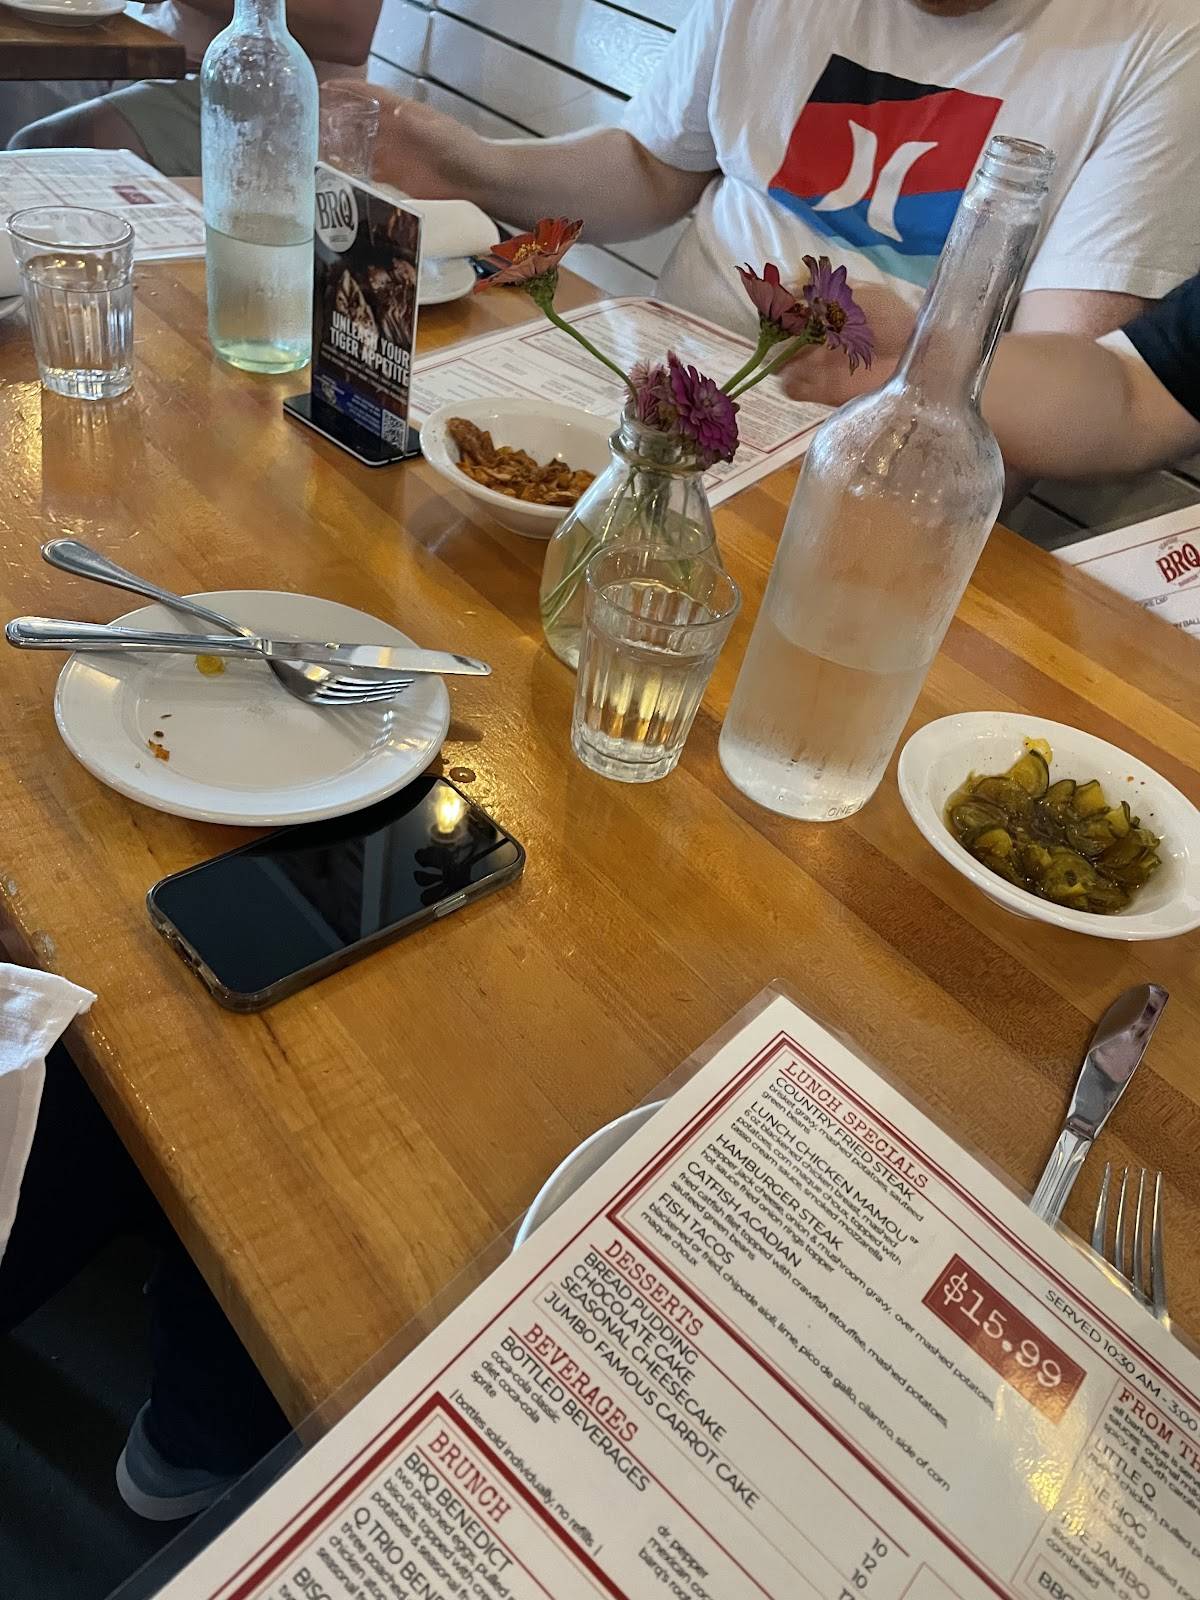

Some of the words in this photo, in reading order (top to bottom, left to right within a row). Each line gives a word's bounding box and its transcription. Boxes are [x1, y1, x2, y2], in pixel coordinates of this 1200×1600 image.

[316, 188, 354, 232] BRQ
[330, 327, 359, 358] TIGER
[361, 346, 410, 387] APPETITE
[332, 310, 378, 351] UNLEASH
[380, 338, 411, 369] YOUR
[1156, 543, 1200, 583] BRQ
[750, 1100, 797, 1143] LUNCH
[795, 1141, 854, 1194] CHICKEN
[760, 1090, 787, 1114] green
[784, 1109, 811, 1135] beans
[768, 1083, 796, 1109] brisket
[793, 1106, 819, 1132] gravy,
[818, 1127, 853, 1159] mashed
[776, 1077, 837, 1128] COUNTRY
[834, 1127, 873, 1163] FRIED
[872, 1161, 915, 1201] STEAK
[784, 1060, 843, 1113] LUNCH
[842, 1111, 928, 1188] SPECIALS
[640, 1211, 672, 1242] maque
[671, 1240, 698, 1267] choux
[658, 1192, 691, 1223] FISH
[689, 1218, 735, 1264] TACOS
[670, 1180, 706, 1213] sauteed
[702, 1211, 729, 1236] green
[728, 1233, 755, 1260] beans
[687, 1161, 742, 1212] CATFISH
[738, 1210, 802, 1268] ACADIAN
[699, 1148, 717, 1167] hot
[713, 1162, 741, 1187] sauce
[738, 1183, 761, 1205] fried
[757, 1202, 784, 1227] onion
[781, 1223, 806, 1248] rings
[804, 1244, 835, 1272] topper
[715, 1133, 800, 1212] HAMBURGER
[798, 1208, 843, 1251] STEAK
[729, 1121, 753, 1144] tasso
[751, 1142, 778, 1167] cream
[803, 1188, 839, 1221] smoked
[837, 1219, 883, 1262] mozzarella
[749, 1114, 762, 1127] oz
[759, 1122, 803, 1162] blackened
[801, 1160, 834, 1192] chicken
[861, 1214, 899, 1248] mashed
[772, 1147, 793, 1168] corn
[791, 1165, 822, 1193] maque
[850, 1216, 883, 1247] topped
[881, 1243, 903, 1267] with
[604, 1239, 704, 1336] DESSERTS
[677, 1170, 700, 1193] fried
[697, 1190, 725, 1217] catfish
[740, 1228, 774, 1260] topped
[771, 1257, 793, 1280] with
[791, 1277, 829, 1313] crawfish
[867, 1348, 907, 1386] mashed
[706, 1143, 738, 1170] pepper
[733, 1168, 756, 1188] jack
[754, 1185, 784, 1216] cheese,
[784, 1212, 811, 1238] onion
[808, 1234, 818, 1245] &
[817, 1242, 866, 1289] mushroom
[865, 1287, 892, 1314] gravy,
[893, 1312, 916, 1334] over
[914, 1332, 954, 1369] mashed
[470, 1370, 497, 1398] sprite
[523, 1322, 638, 1442] BEVERAGES
[648, 1202, 694, 1245] blackened
[690, 1242, 703, 1254] or
[722, 1272, 758, 1307] chipotle
[796, 1344, 821, 1367] pico
[819, 1364, 834, 1380] de
[894, 1435, 917, 1459] side
[914, 1456, 930, 1469] of
[926, 1466, 951, 1492] corn
[943, 1272, 1061, 1402] $15.99
[1045, 1289, 1102, 1343] SERVED
[1103, 1339, 1136, 1374] 10:30
[1135, 1373, 1161, 1398] AM
[1168, 1399, 1198, 1431] 3:00
[455, 1393, 486, 1430] bottles
[483, 1426, 508, 1451] sold
[553, 1502, 570, 1521] no
[500, 1335, 564, 1402] BOTTLED
[561, 1398, 650, 1492] BEVERAGES
[543, 1290, 597, 1344] JUMBO
[593, 1340, 658, 1406] FAMOUS
[655, 1402, 719, 1464] CARROT
[715, 1462, 760, 1510] CAKE
[560, 1275, 630, 1351] SEASONAL
[631, 1345, 727, 1442] CHEESECAKE
[850, 1566, 869, 1590] 10
[573, 1264, 657, 1348] CHOCOLATE
[654, 1344, 696, 1386] CAKE
[860, 1551, 878, 1574] 12
[583, 1251, 632, 1300] BREAD
[630, 1296, 698, 1365] PUDDING
[871, 1536, 889, 1559] 10
[1118, 1386, 1174, 1444] FROM
[403, 1451, 440, 1496] BRQ
[435, 1487, 513, 1572] BENEDICT
[427, 1429, 511, 1523] BRUNCH
[480, 1359, 501, 1382] diet
[498, 1378, 540, 1424] coca-cola
[647, 1537, 691, 1584] mexican
[490, 1350, 532, 1394] coca-cola
[530, 1392, 560, 1424] classic
[669, 1539, 709, 1578] pepper
[1141, 1481, 1157, 1503] Q
[316, 1547, 360, 1595] seasonal
[329, 1535, 366, 1579] chicken
[340, 1521, 367, 1554] three
[352, 1506, 372, 1531] Q
[367, 1519, 404, 1565] TRIO
[370, 1491, 413, 1538] potatoes
[409, 1534, 422, 1548] &
[417, 1545, 461, 1592] seasonal
[393, 1465, 415, 1491] two
[410, 1488, 455, 1536] poached
[474, 1562, 510, 1598] pulled
[417, 1518, 455, 1560] topped
[450, 1556, 475, 1586] with
